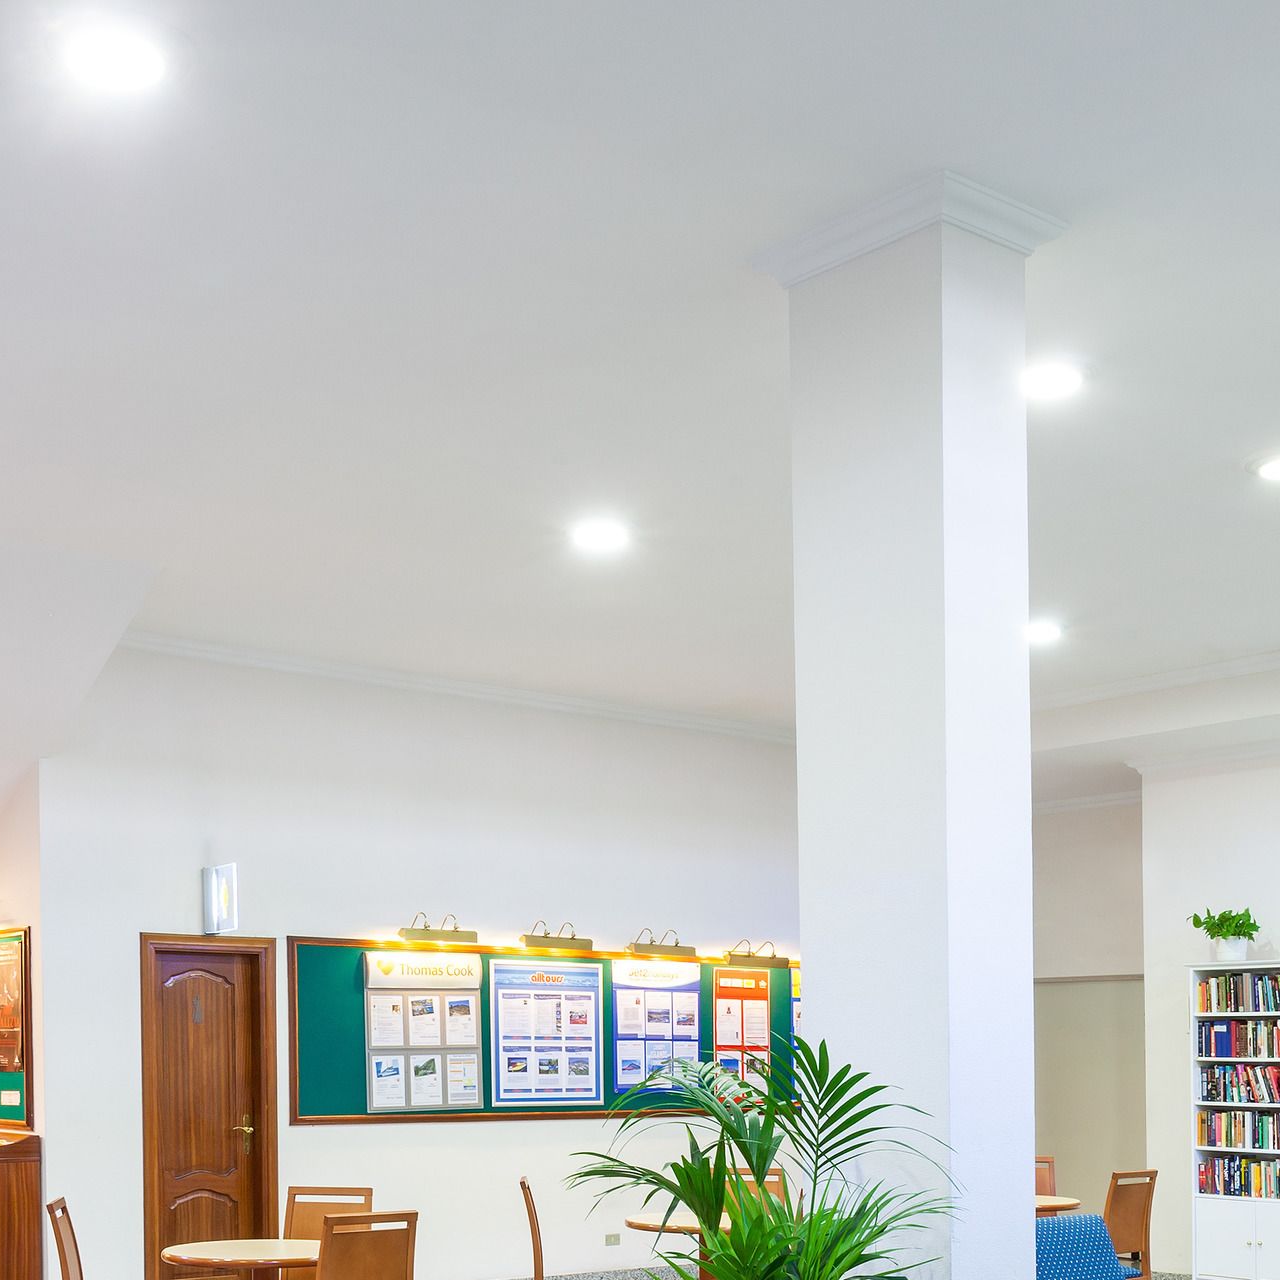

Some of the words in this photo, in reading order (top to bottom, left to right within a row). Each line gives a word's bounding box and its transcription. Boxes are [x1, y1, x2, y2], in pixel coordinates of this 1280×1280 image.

[400, 963, 443, 976] Thomas
[446, 964, 474, 977] Cook
[530, 971, 565, 984] alltours
